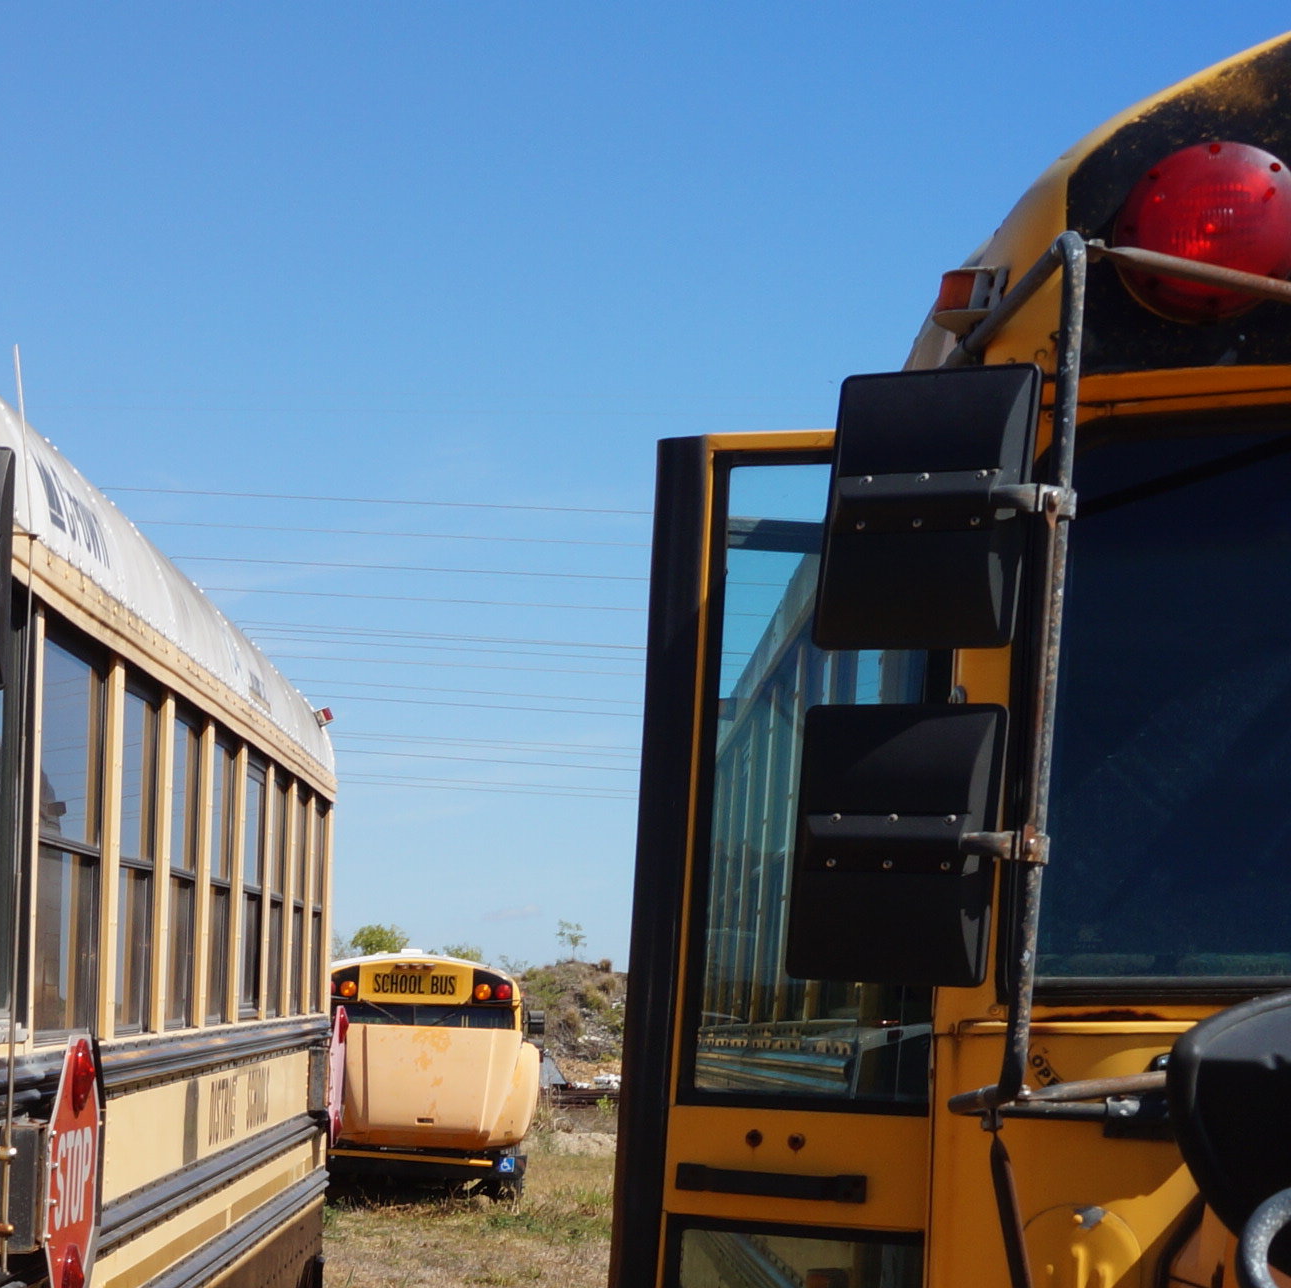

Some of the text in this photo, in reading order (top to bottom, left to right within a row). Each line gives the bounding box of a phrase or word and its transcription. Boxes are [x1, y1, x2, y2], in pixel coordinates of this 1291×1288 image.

[374, 974, 456, 995] SCHOOL BUS
[55, 1126, 93, 1231] STOP
